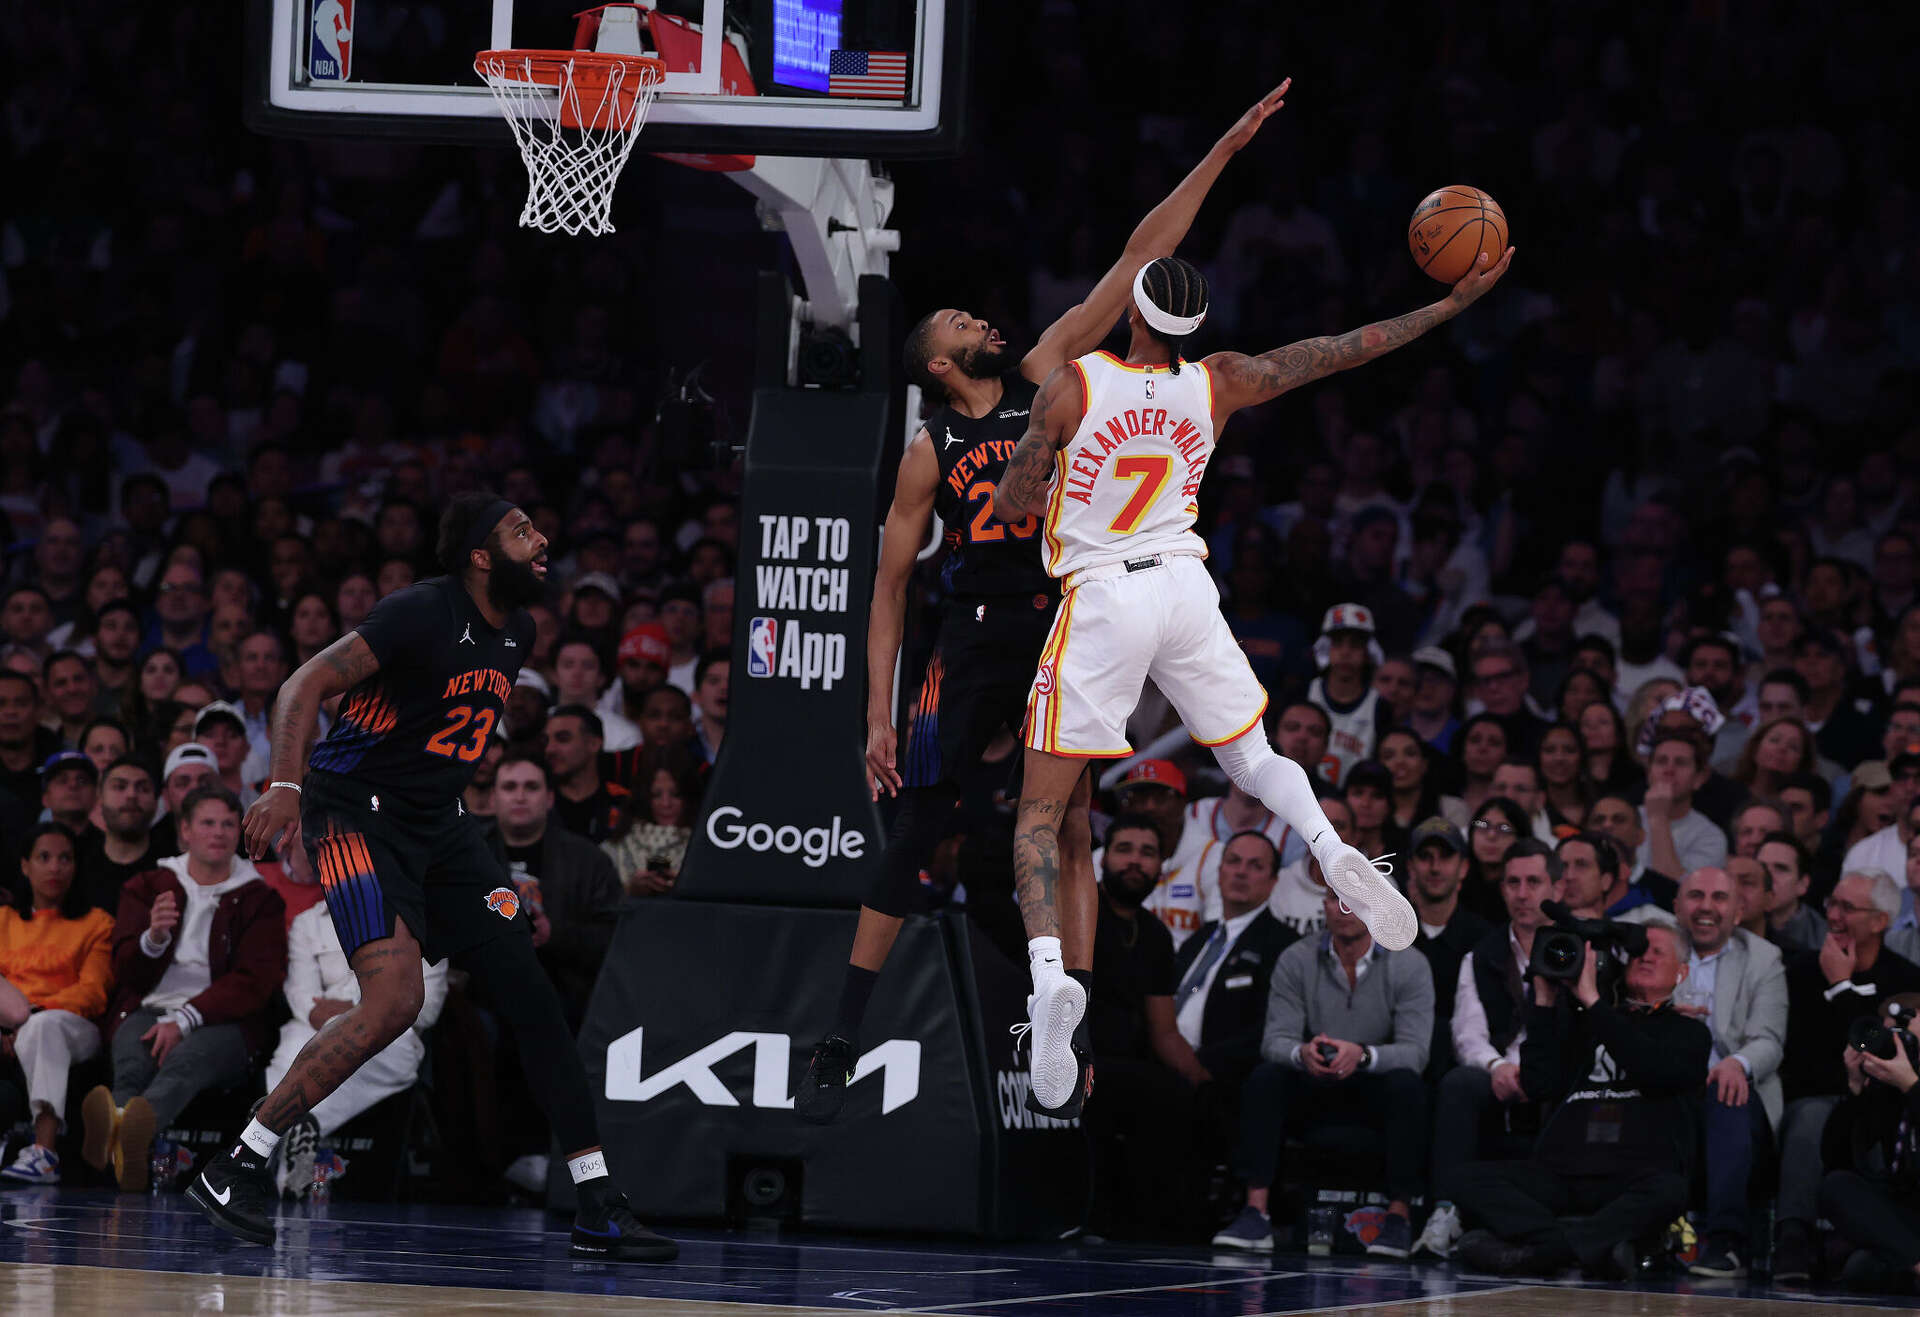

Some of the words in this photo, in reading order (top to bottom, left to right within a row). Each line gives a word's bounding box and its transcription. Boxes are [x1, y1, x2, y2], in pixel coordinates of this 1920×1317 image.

[315, 60, 335, 76] NBA
[948, 442, 989, 498] NEW
[987, 440, 1020, 462] YO
[1066, 408, 1206, 505] ALEXANDER-WALKER
[1107, 455, 1173, 535] 7
[759, 515, 810, 560] TAP
[815, 517, 850, 562] TO
[756, 565, 849, 612] WATCH
[442, 668, 488, 699] NEW
[778, 620, 846, 690] App
[425, 704, 496, 762] 23
[706, 806, 865, 868] Google
[605, 1026, 921, 1115] KIA
